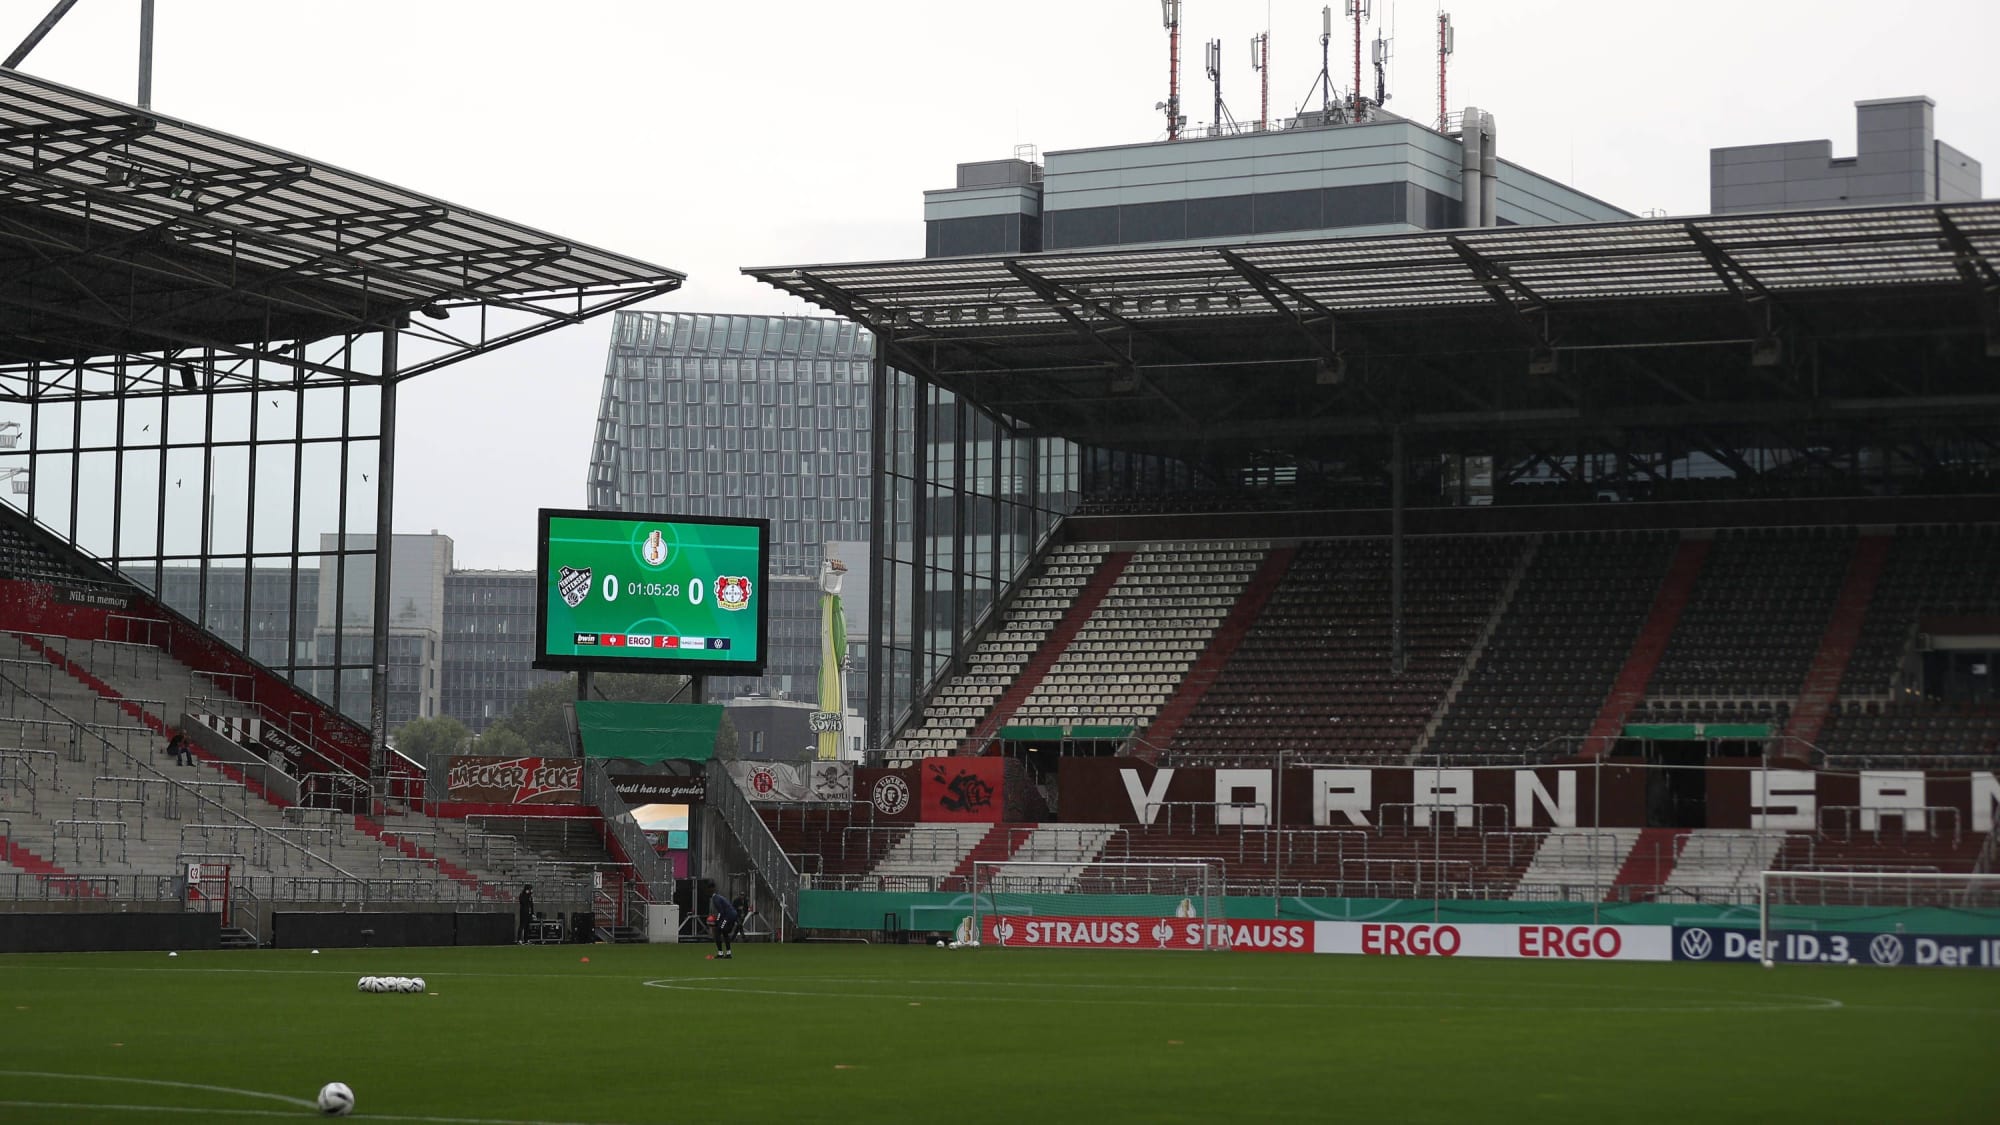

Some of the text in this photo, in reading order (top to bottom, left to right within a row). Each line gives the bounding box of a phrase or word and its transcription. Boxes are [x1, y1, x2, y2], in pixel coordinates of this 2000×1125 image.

[69, 591, 128, 609] Nils in memory
[602, 574, 619, 602] 0
[628, 582, 680, 598] 01:05:28
[688, 578, 704, 605] 0
[628, 637, 651, 645] ERGO
[285, 741, 303, 757] die
[451, 765, 578, 790] MECKER ECKE
[640, 784, 657, 793] has
[671, 785, 705, 798] gender
[1120, 768, 1577, 828] VORAN
[190, 867, 199, 880] C2
[1025, 921, 1140, 944] STRAUSS
[1185, 923, 1304, 948] STRAUSS
[1361, 923, 1462, 957] ERGO
[1518, 925, 1622, 958] ERGO
[1724, 931, 1849, 962] Der ID.3
[1915, 938, 1974, 966] Der
